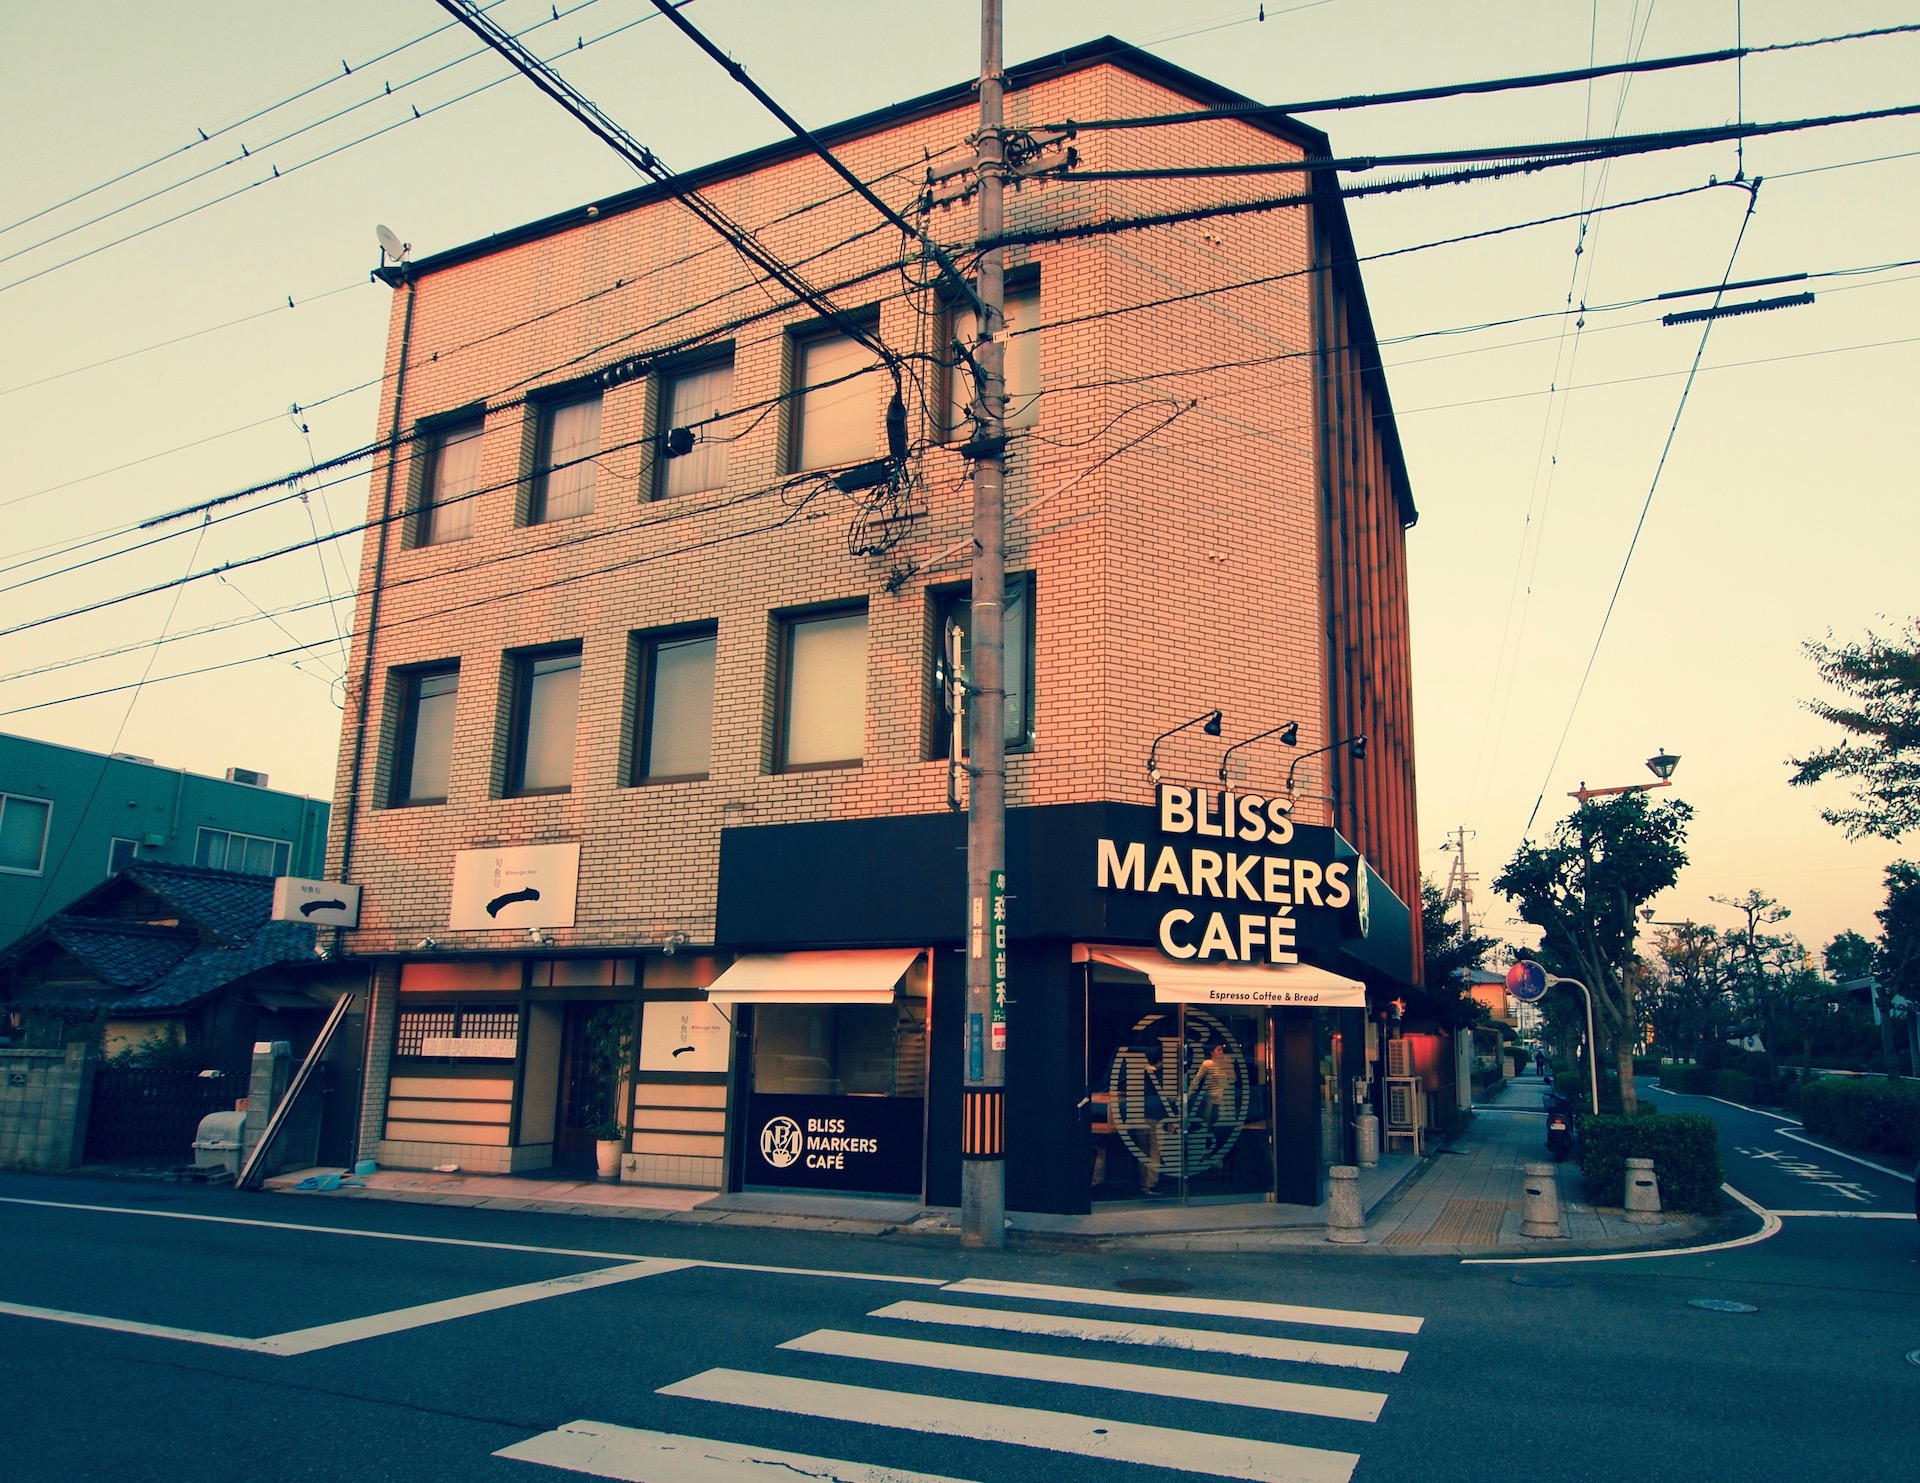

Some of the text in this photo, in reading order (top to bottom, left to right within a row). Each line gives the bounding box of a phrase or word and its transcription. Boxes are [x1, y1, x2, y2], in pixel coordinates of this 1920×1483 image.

[1161, 784, 1294, 845] BLISS
[1097, 838, 1350, 909] MARKERS
[1159, 906, 1298, 965] CAFÉ
[1209, 990, 1319, 1002] Espresso Coffee & Bread
[807, 1118, 845, 1133] BLISS
[806, 1136, 878, 1153] MARKERS
[806, 1152, 845, 1170] CAFÉ
